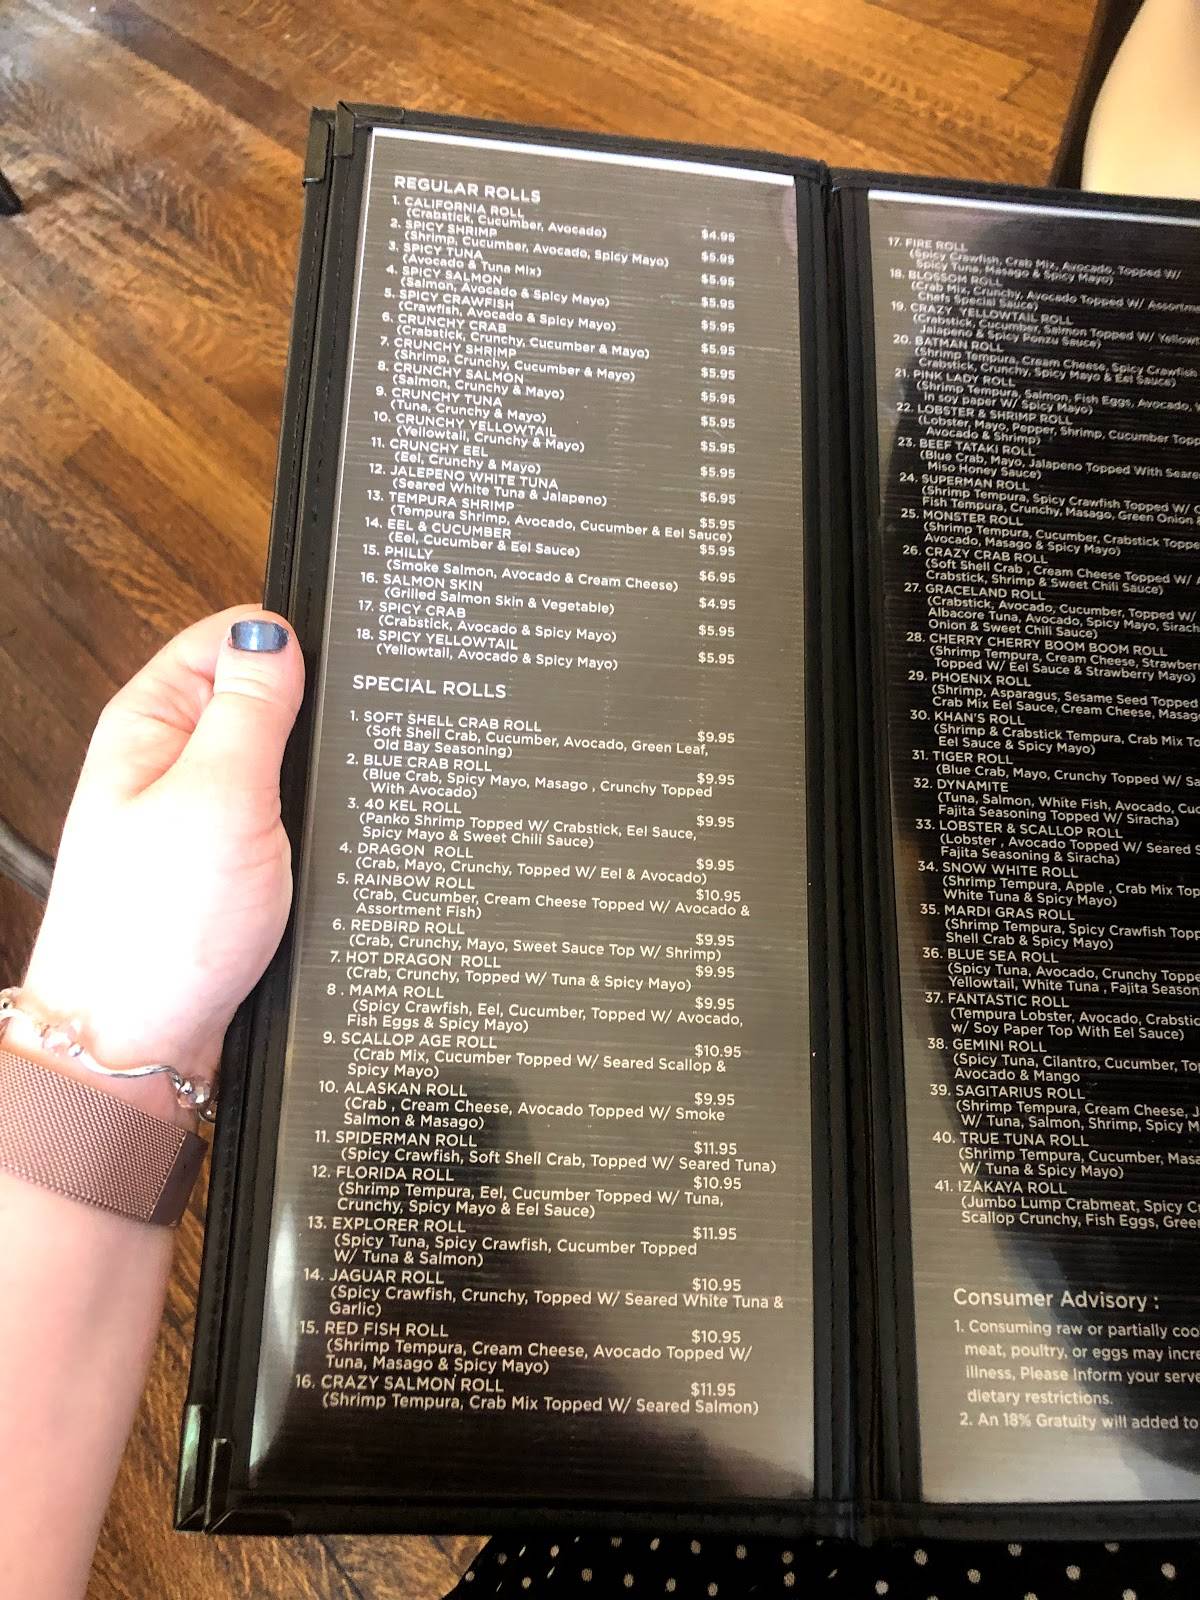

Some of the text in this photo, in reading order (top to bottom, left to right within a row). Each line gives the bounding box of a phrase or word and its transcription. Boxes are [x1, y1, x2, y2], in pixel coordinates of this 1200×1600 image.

[393, 176, 541, 203] REGULAR ROLLS
[404, 196, 486, 214] CALIFORNIA
[489, 204, 525, 218] ROLL
[700, 228, 735, 243] $4.95
[402, 242, 442, 257] SPICY
[445, 246, 483, 261] TUNA
[904, 237, 932, 250] FIRE
[935, 240, 968, 253] ROLL
[393, 337, 461, 354] CRUNCHY
[464, 343, 517, 358] SHRIMP
[914, 335, 968, 350] BATMAN
[970, 339, 1004, 353] ROLL
[372, 411, 557, 438] 10. CRUNCHY YELLOWTAIL
[699, 440, 735, 455] $5.95
[368, 463, 559, 490] 12. JALEPENO WHITE TUNA
[699, 491, 736, 506] $6.95
[362, 544, 433, 561] 15. PHILLY
[902, 544, 1048, 564] 26. CRAZY CRAB ROLL
[385, 558, 680, 594] (Smoke Salmon, Avocado & Cream Cheese)
[698, 570, 736, 585] $6.95
[355, 628, 518, 651] 18. SPICY YELLOWTAIL
[905, 631, 1168, 657] 28. CHERRY CHERRY BOOM BOOM ROLL
[375, 643, 618, 673] (Yellowtail, Avocado & Spicy Mayo)
[697, 651, 735, 666] $5.95
[352, 675, 506, 699] SPECIAL ROLLS
[349, 710, 542, 733] 1. SOFT SHELL CRAB ROLL
[909, 709, 1025, 726] 30. KHAN'S ROLL
[365, 725, 708, 757] (Soft Shell Crab, Cucumber, Avocado, Green Leaf,
[696, 730, 735, 745] $9.95
[346, 798, 462, 814] 3. 40 KEL ROLL
[695, 814, 735, 829] $9.95
[914, 818, 1123, 839] 33. LOBSTER & SCALLOP ROLL
[336, 873, 475, 890] 5. RAINBOW ROLL
[695, 888, 741, 904] $10.95
[355, 902, 482, 921] Assortment Fish)
[322, 1032, 497, 1049] 9. SCALLOP AGE ROLL
[693, 1044, 741, 1059] $10.95
[319, 1080, 468, 1097] 10. ALASKAN ROLL
[929, 1083, 1086, 1099] 39. SAGITARIUS ROLL
[693, 1092, 735, 1108] $9.95
[343, 1112, 484, 1132] Salmon & Masago)
[934, 1180, 1067, 1195] 41. IZAKAYA ROLL
[303, 1268, 444, 1284] 14. JAGUAR ROLL
[691, 1277, 741, 1294] $10.95
[329, 1301, 381, 1319] Garlic)
[953, 1289, 1054, 1308] Consumer
[1059, 1292, 1147, 1314] Advisory
[953, 1319, 1168, 1340] 1. Consuming raw or partially
[964, 1342, 1164, 1363] meat, poultry, or eggs may
[295, 1375, 504, 1393] 16. CRAZY SALMON ROLL
[690, 1382, 736, 1398] $11.95
[322, 1393, 758, 1417] (Shrimp Tempura, Crab Mix Topped W/ Seared Salmon)
[966, 1389, 1113, 1407] dietary restrictions.
[959, 1413, 1199, 1431] 2. An 18% Gratuity will added to
